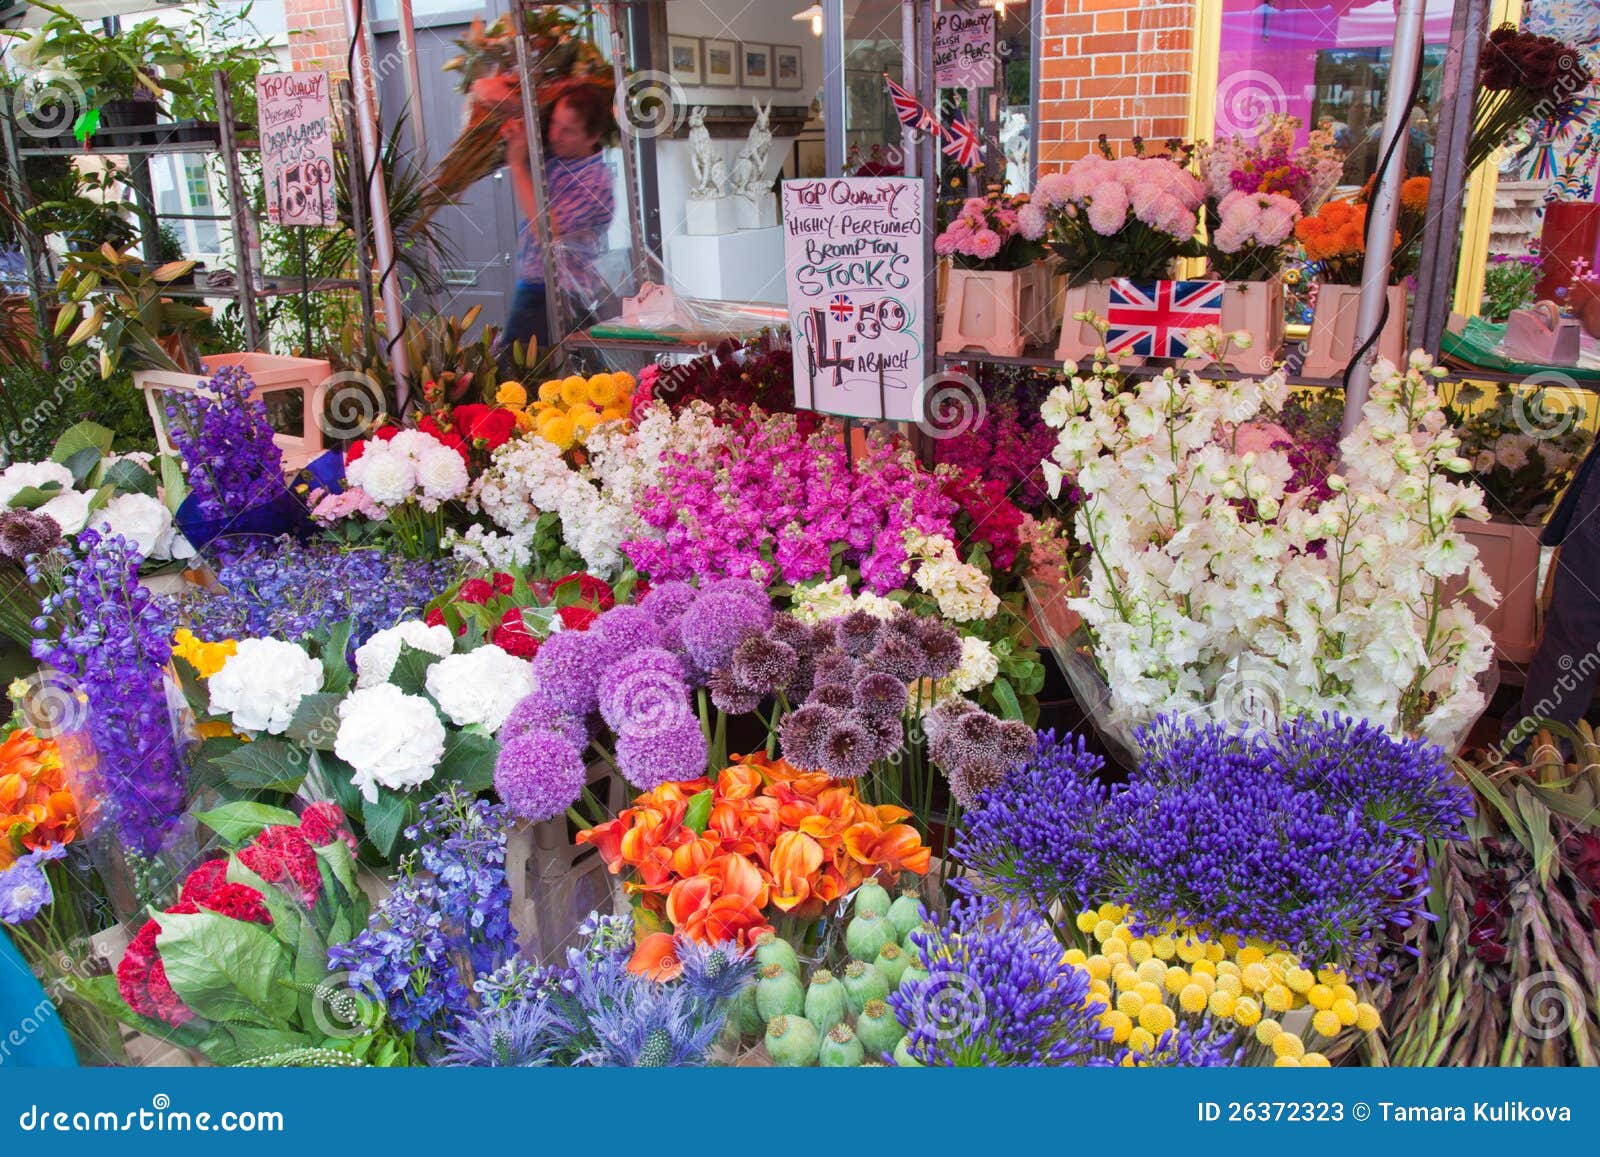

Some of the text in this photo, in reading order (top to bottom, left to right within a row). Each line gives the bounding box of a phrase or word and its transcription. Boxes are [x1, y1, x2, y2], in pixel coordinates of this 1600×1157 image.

[950, 14, 992, 34] QUALITY
[260, 74, 323, 101] TOP QUALITY
[275, 158, 331, 217] 5.00
[786, 180, 907, 218] TOP QUALITY
[806, 238, 898, 264] BROMPTON
[797, 254, 909, 296] STOCKS
